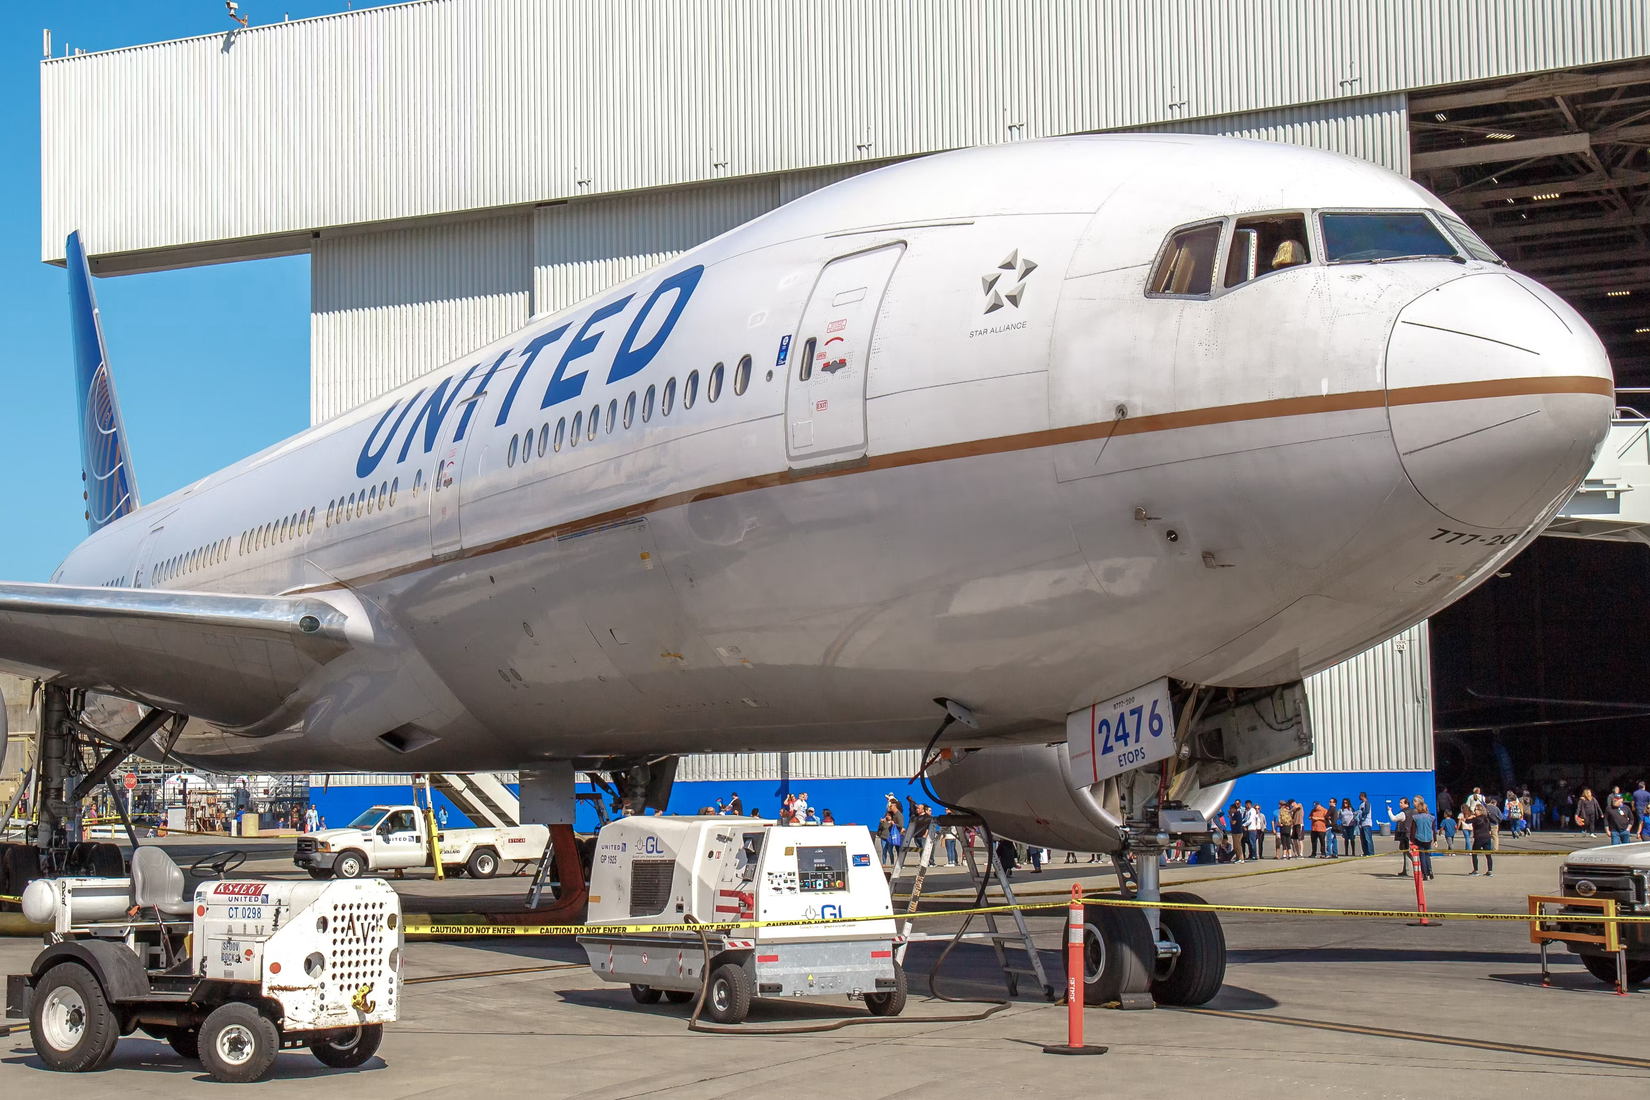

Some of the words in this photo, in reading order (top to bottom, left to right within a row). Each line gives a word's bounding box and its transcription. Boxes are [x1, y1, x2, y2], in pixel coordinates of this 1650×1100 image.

[969, 328, 988, 338] STAR
[989, 321, 1027, 334] ALLIANCE
[356, 264, 705, 479] UNITED
[817, 402, 827, 410] EXIT
[1428, 528, 1531, 546] 777-20
[1098, 699, 1163, 755] 2476
[1118, 747, 1145, 767] ETOPS
[125, 777, 137, 785] STOP
[646, 836, 664, 854] GL
[217, 883, 263, 895] KS4E67
[228, 907, 239, 919] CT
[242, 907, 262, 919] 0298
[430, 926, 462, 934] CAUTION
[464, 926, 474, 934] DO
[475, 926, 490, 934] NOT
